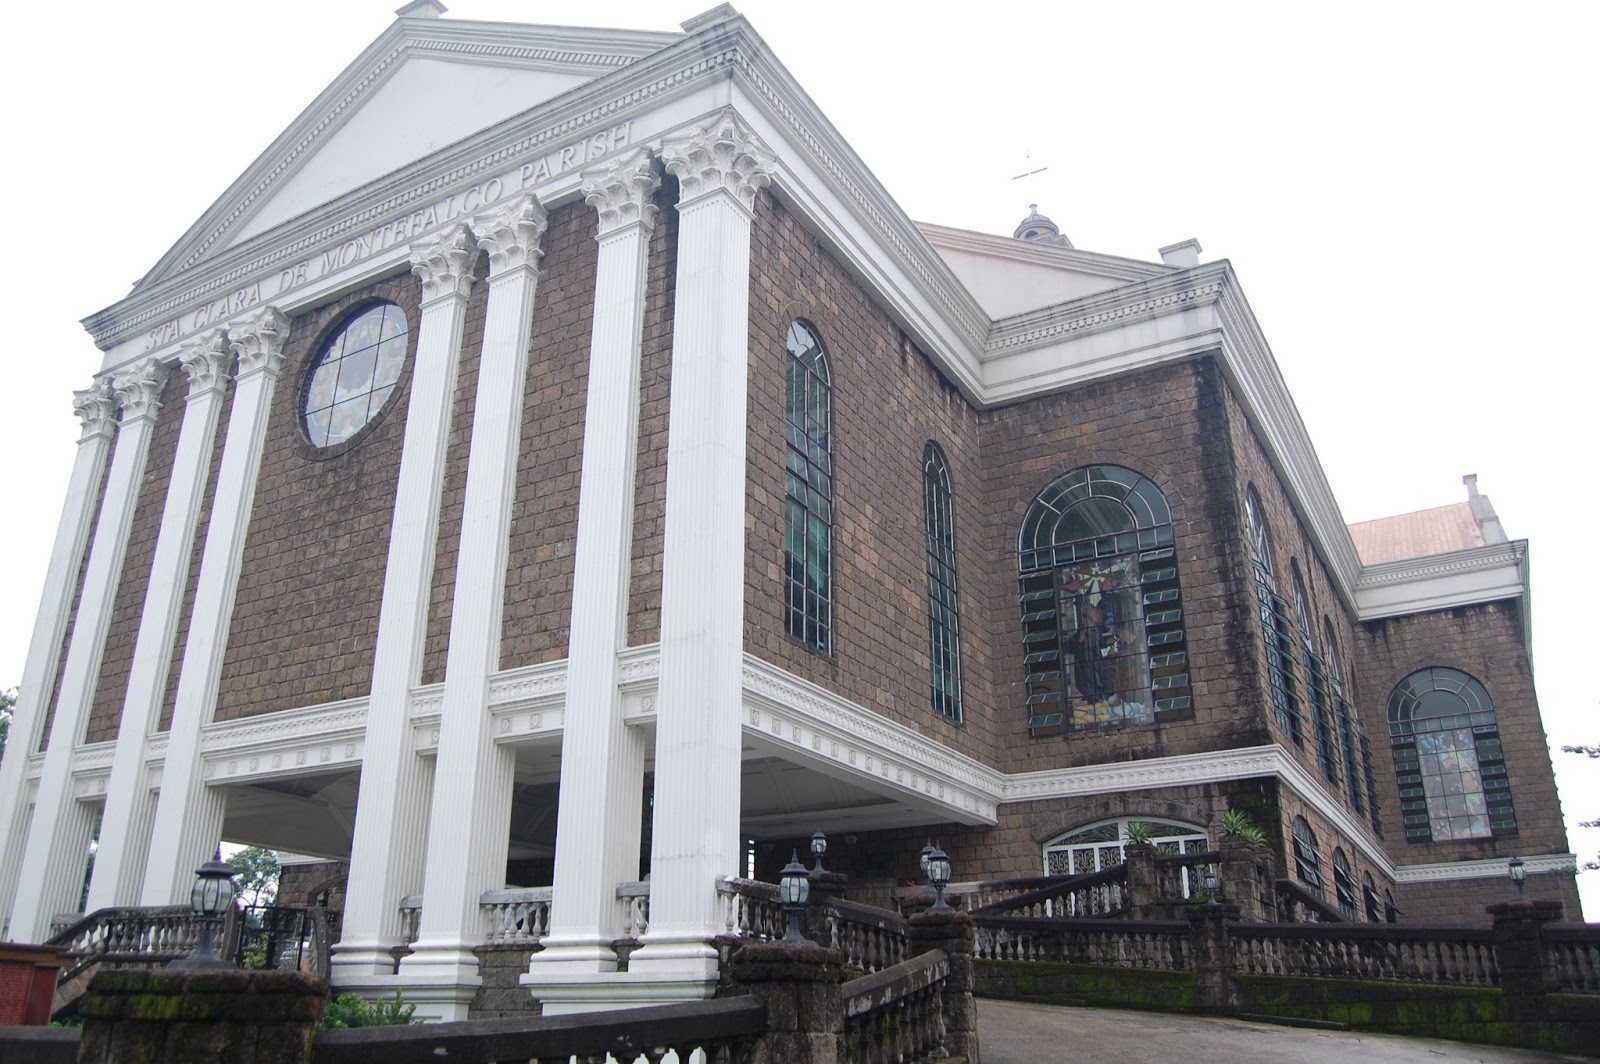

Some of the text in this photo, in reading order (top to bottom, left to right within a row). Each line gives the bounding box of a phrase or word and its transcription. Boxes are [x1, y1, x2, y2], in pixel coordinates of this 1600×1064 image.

[193, 283, 261, 329] CLARA
[275, 262, 309, 297] DE
[318, 178, 503, 277] MONTEFALCO
[519, 120, 634, 188] PARISH
